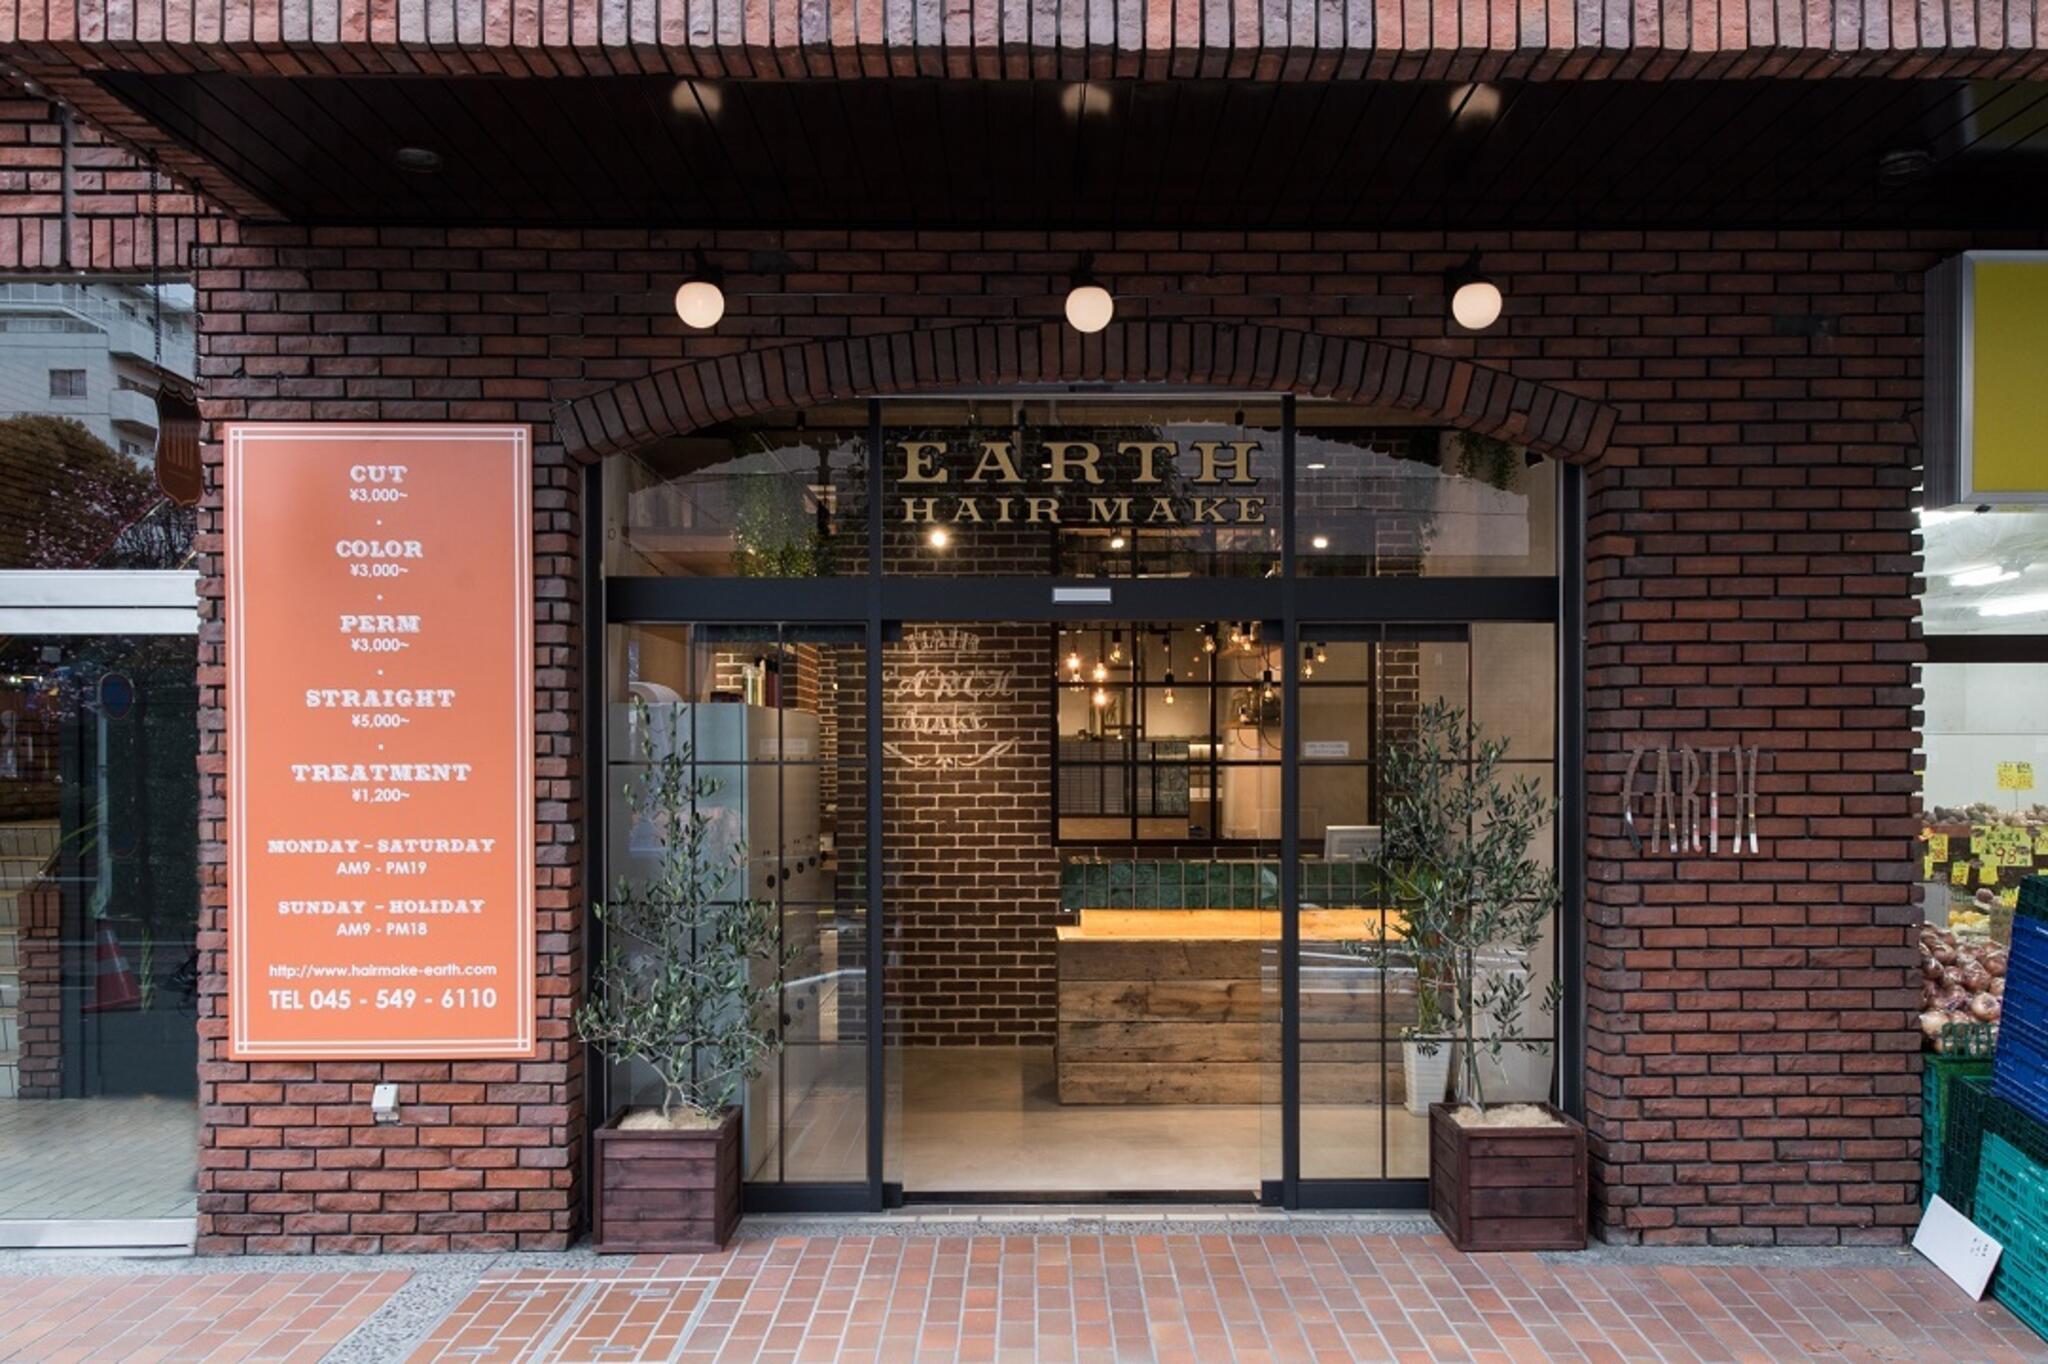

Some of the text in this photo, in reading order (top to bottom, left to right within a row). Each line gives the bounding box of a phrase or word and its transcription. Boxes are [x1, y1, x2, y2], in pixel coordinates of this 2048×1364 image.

[897, 441, 1261, 483] EARTH
[350, 465, 408, 484] CUT
[900, 497, 1266, 524] HAIR MAKE
[335, 540, 423, 558] COLOR
[339, 615, 421, 633] PERM
[305, 689, 456, 708] STRAIGHT
[291, 764, 472, 782] TREATMENT
[1620, 744, 1759, 854] EARTH
[267, 840, 360, 853] MONDAY
[377, 839, 496, 853] SATURDAY
[336, 861, 371, 875] AM9
[386, 861, 427, 875] PM19
[278, 901, 366, 915] SUNDAY
[389, 899, 486, 914] HOLIDAY
[336, 922, 371, 936] AM9
[386, 922, 427, 936] PM18
[269, 963, 497, 980] http://www.hairmake-earth.com
[269, 990, 303, 1010] TEL
[310, 989, 351, 1010] 045
[375, 988, 417, 1009] 549
[441, 988, 497, 1009] 6110
